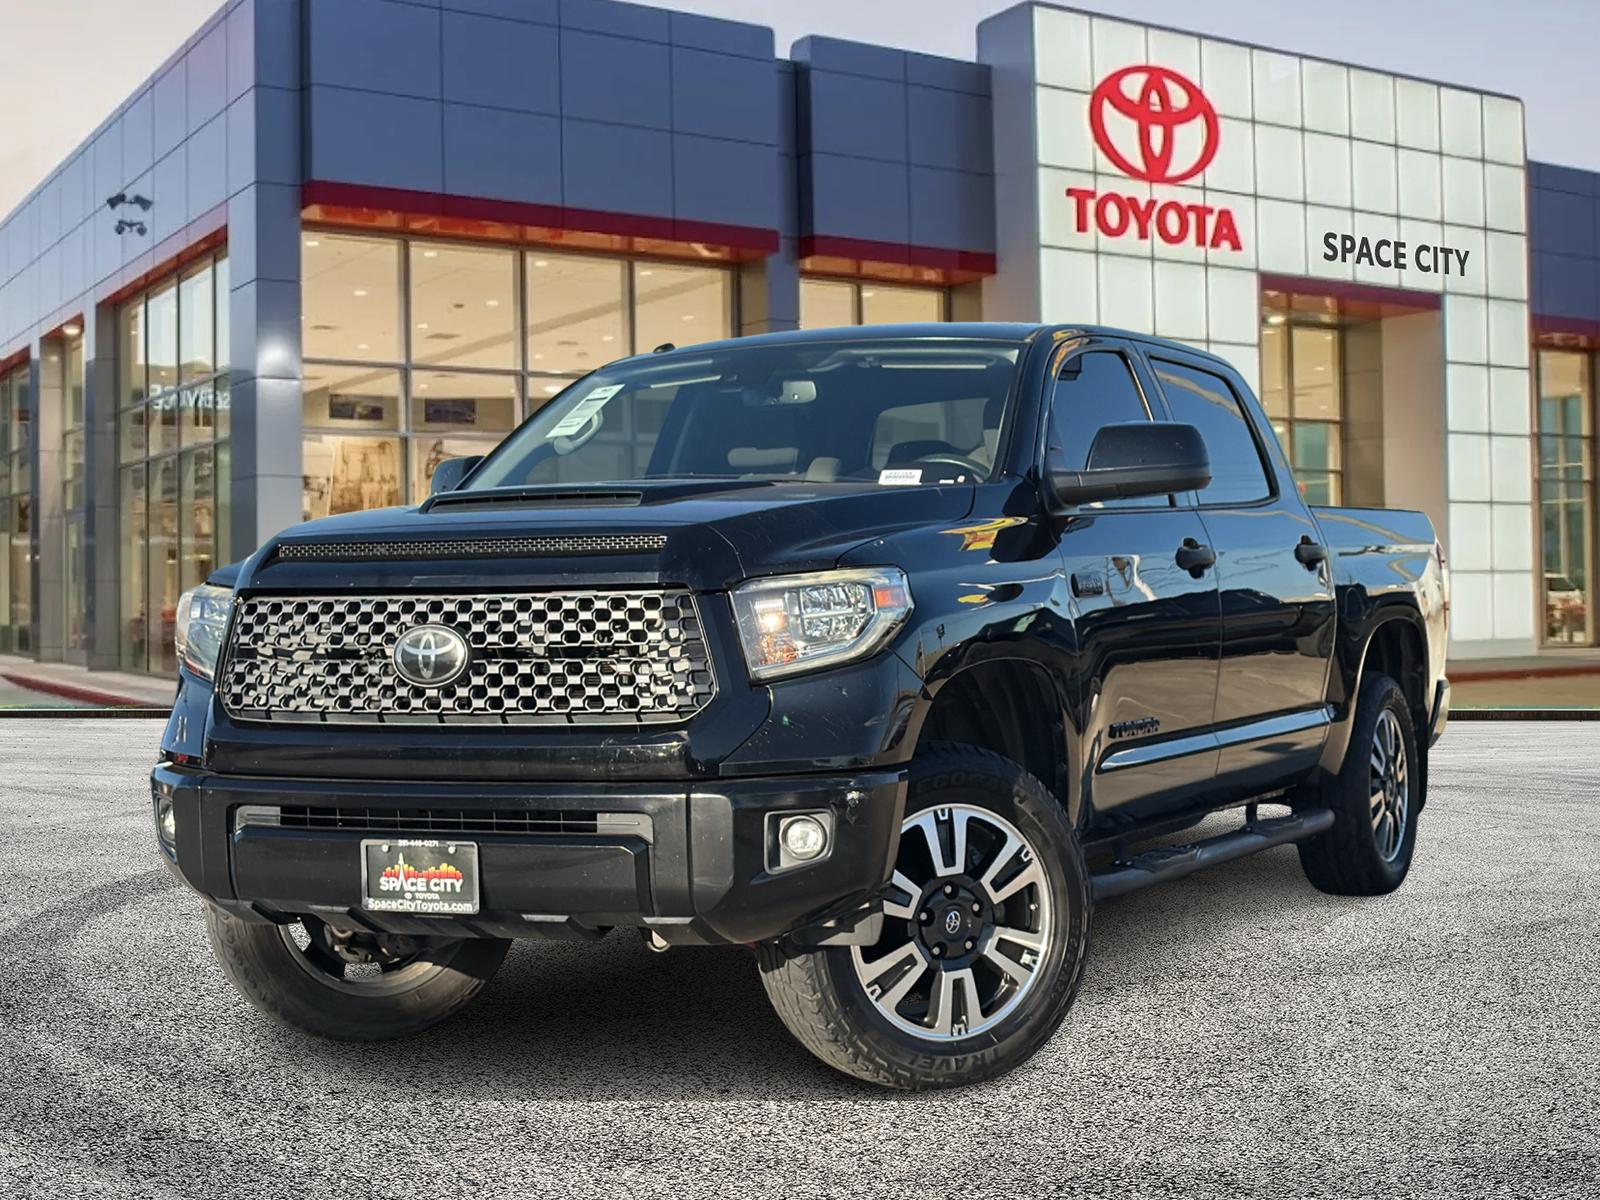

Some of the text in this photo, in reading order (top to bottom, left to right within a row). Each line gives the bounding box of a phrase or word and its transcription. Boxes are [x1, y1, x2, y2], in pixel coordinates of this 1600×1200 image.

[1066, 188, 1242, 251] TOYOTA
[1323, 231, 1470, 277] SPACE CITY
[380, 876, 464, 893] SPACE CITY
[415, 892, 440, 900] TOYOTA
[368, 898, 473, 913] SpaceCityToyota.com
